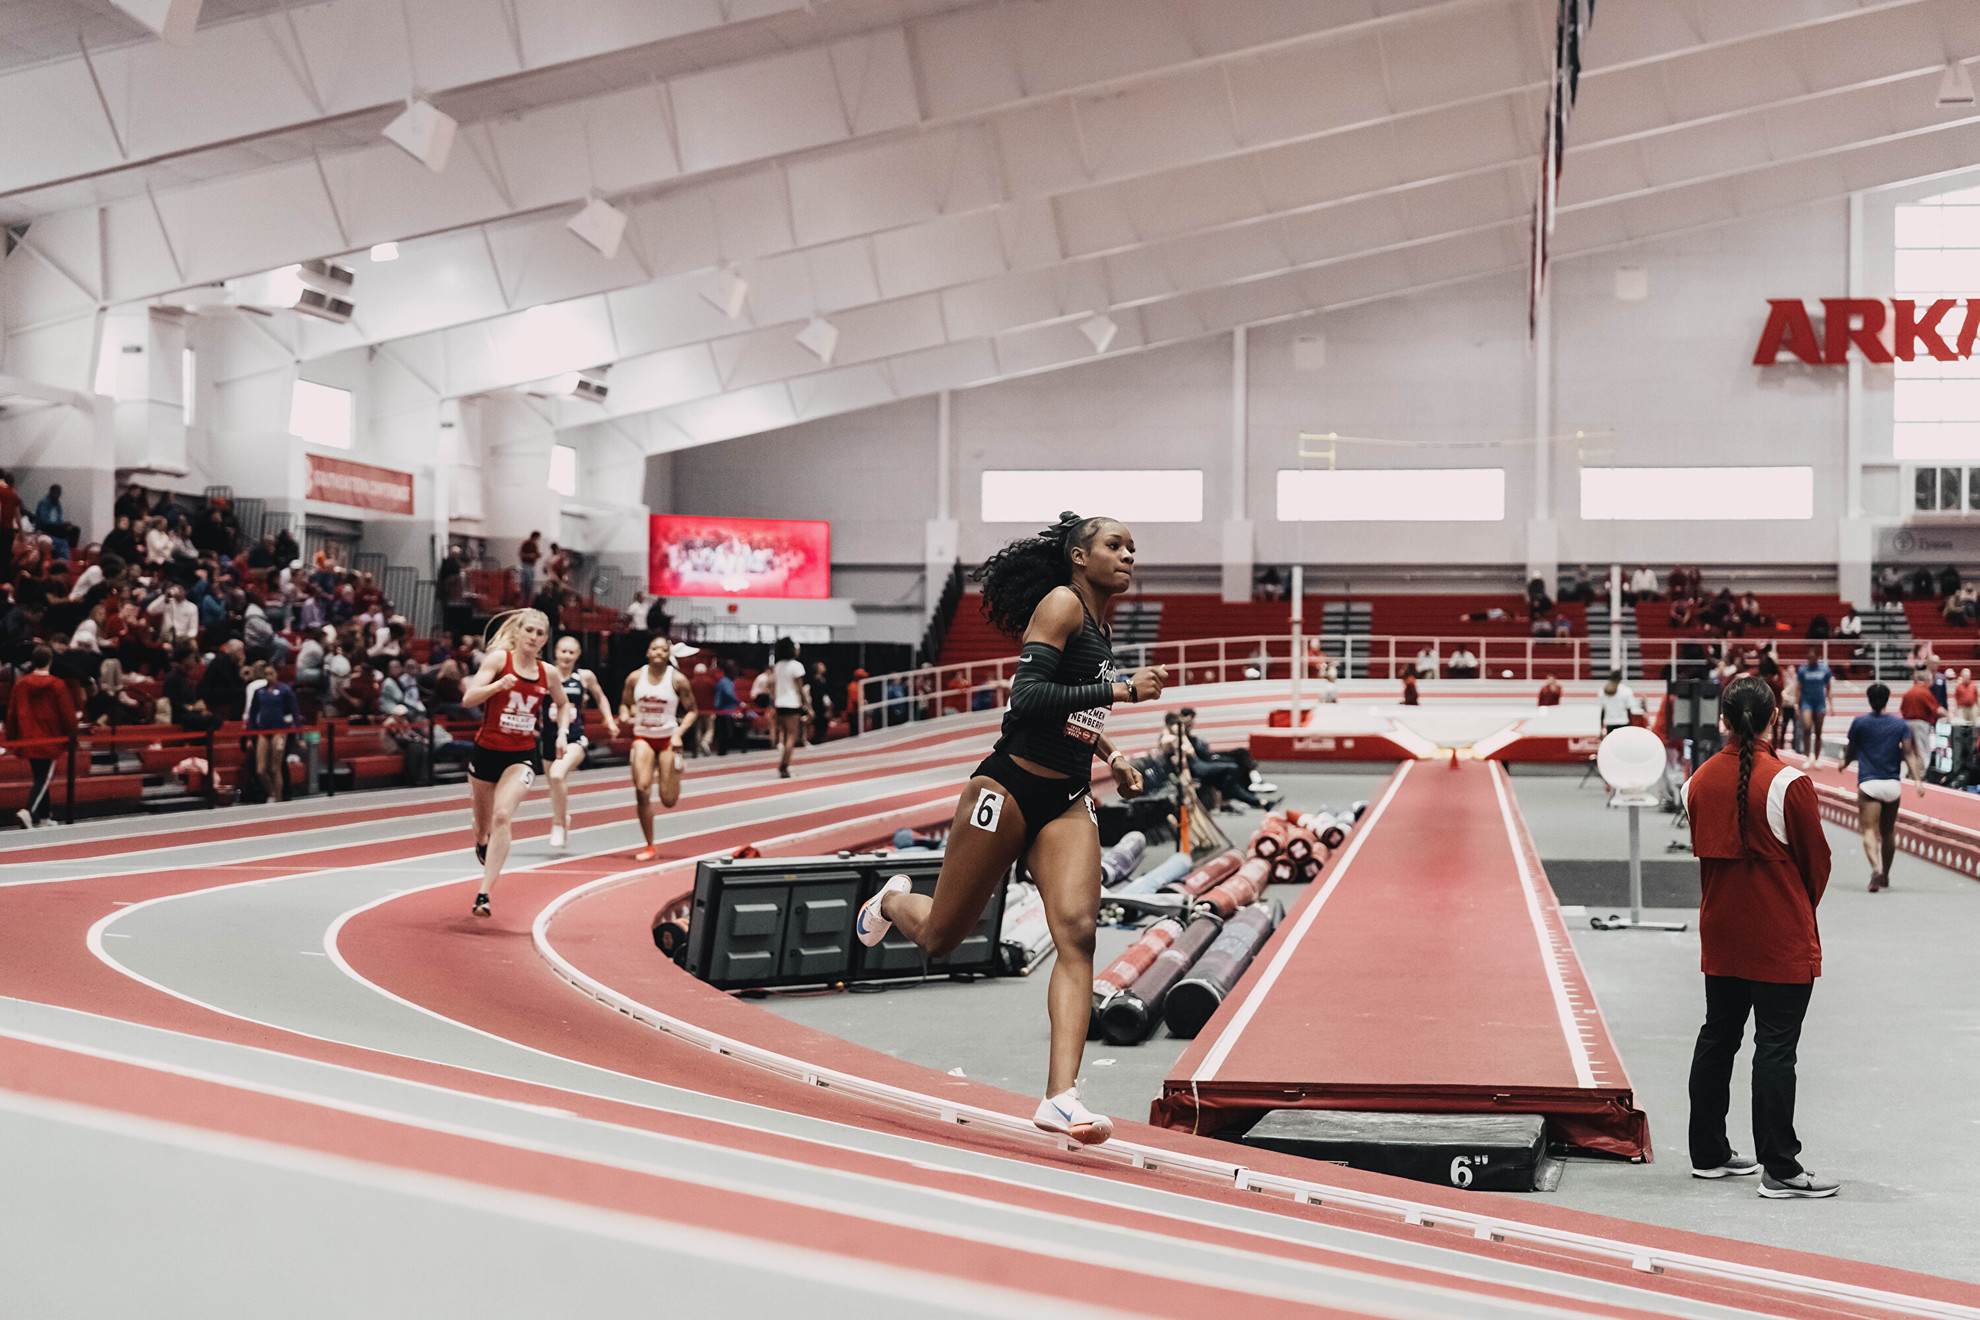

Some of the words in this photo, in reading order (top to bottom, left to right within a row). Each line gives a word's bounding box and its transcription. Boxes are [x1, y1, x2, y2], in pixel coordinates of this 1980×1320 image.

[508, 691, 538, 713] N
[977, 793, 997, 826] 6
[1451, 1155, 1488, 1188] 6"
